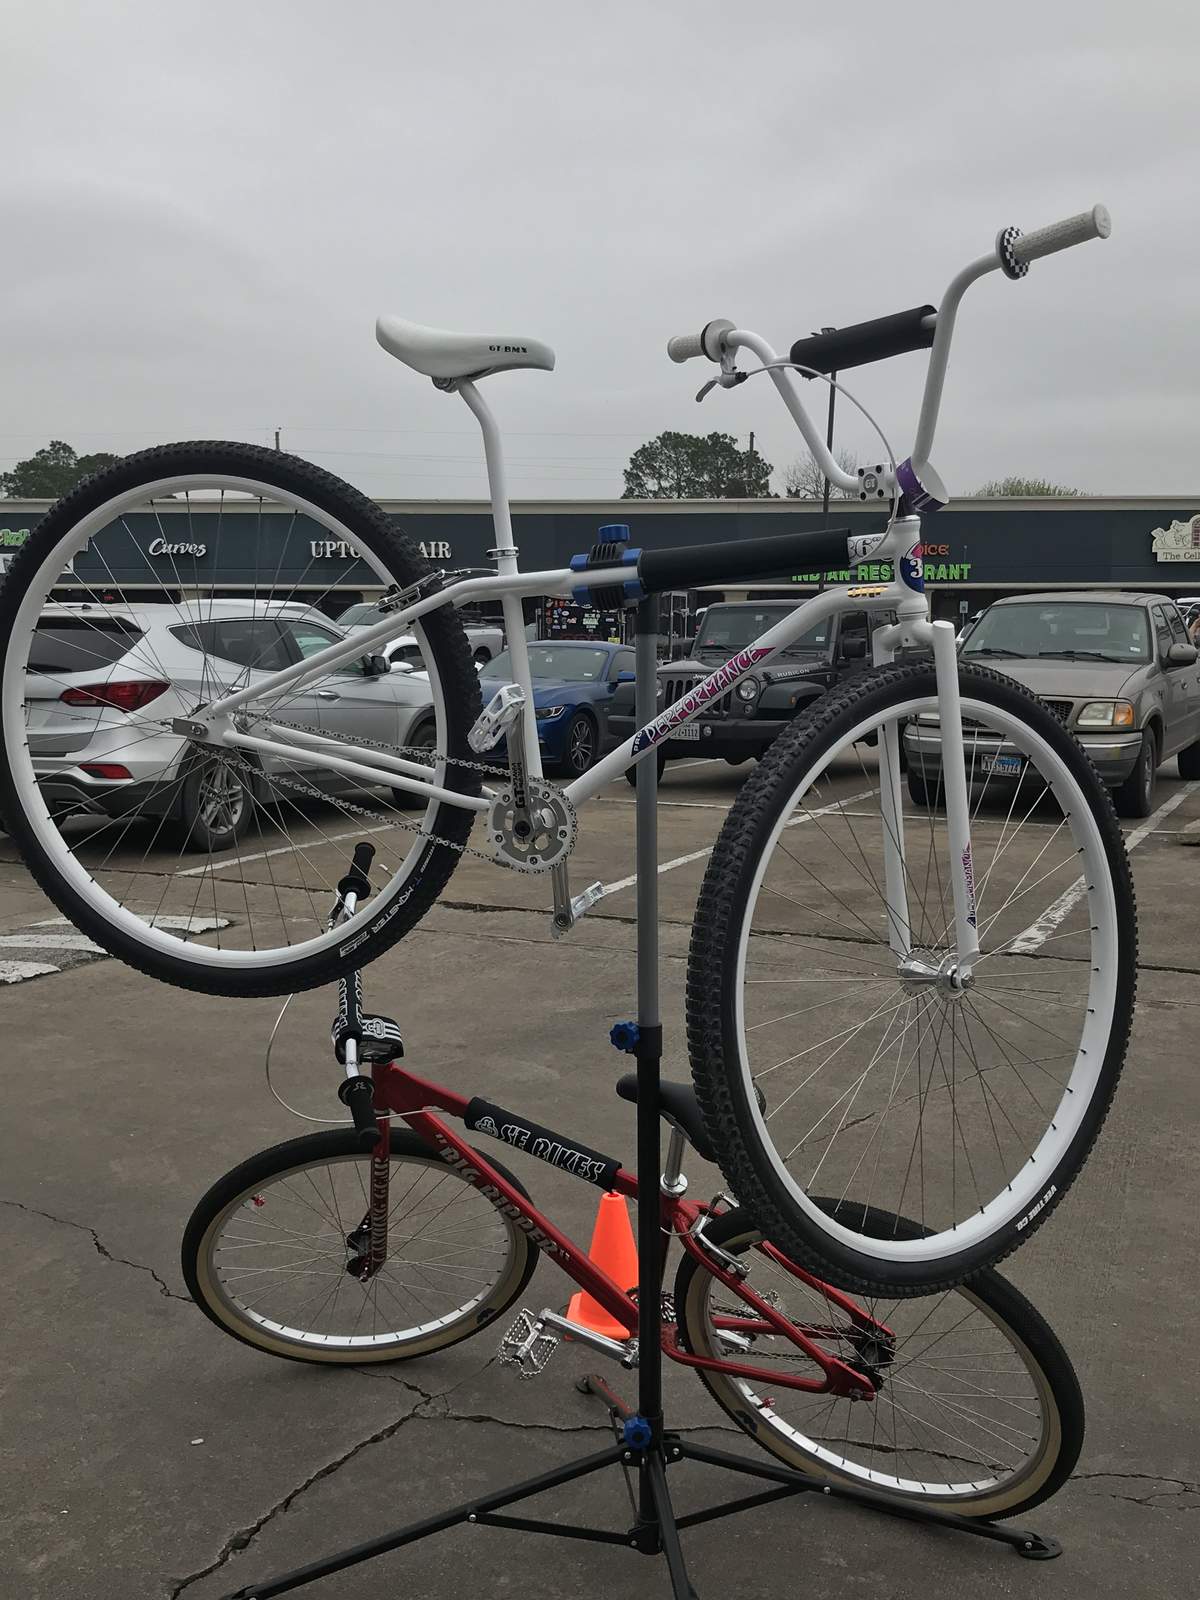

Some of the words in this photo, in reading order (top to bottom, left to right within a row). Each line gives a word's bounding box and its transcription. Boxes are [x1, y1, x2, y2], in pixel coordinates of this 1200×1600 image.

[149, 537, 207, 557] Curves
[1162, 551, 1180, 561] The
[643, 644, 763, 744] PERFORMANCE
[632, 731, 643, 752] PRO
[500, 1123, 531, 1148] SE
[532, 1137, 607, 1183] BIKES
